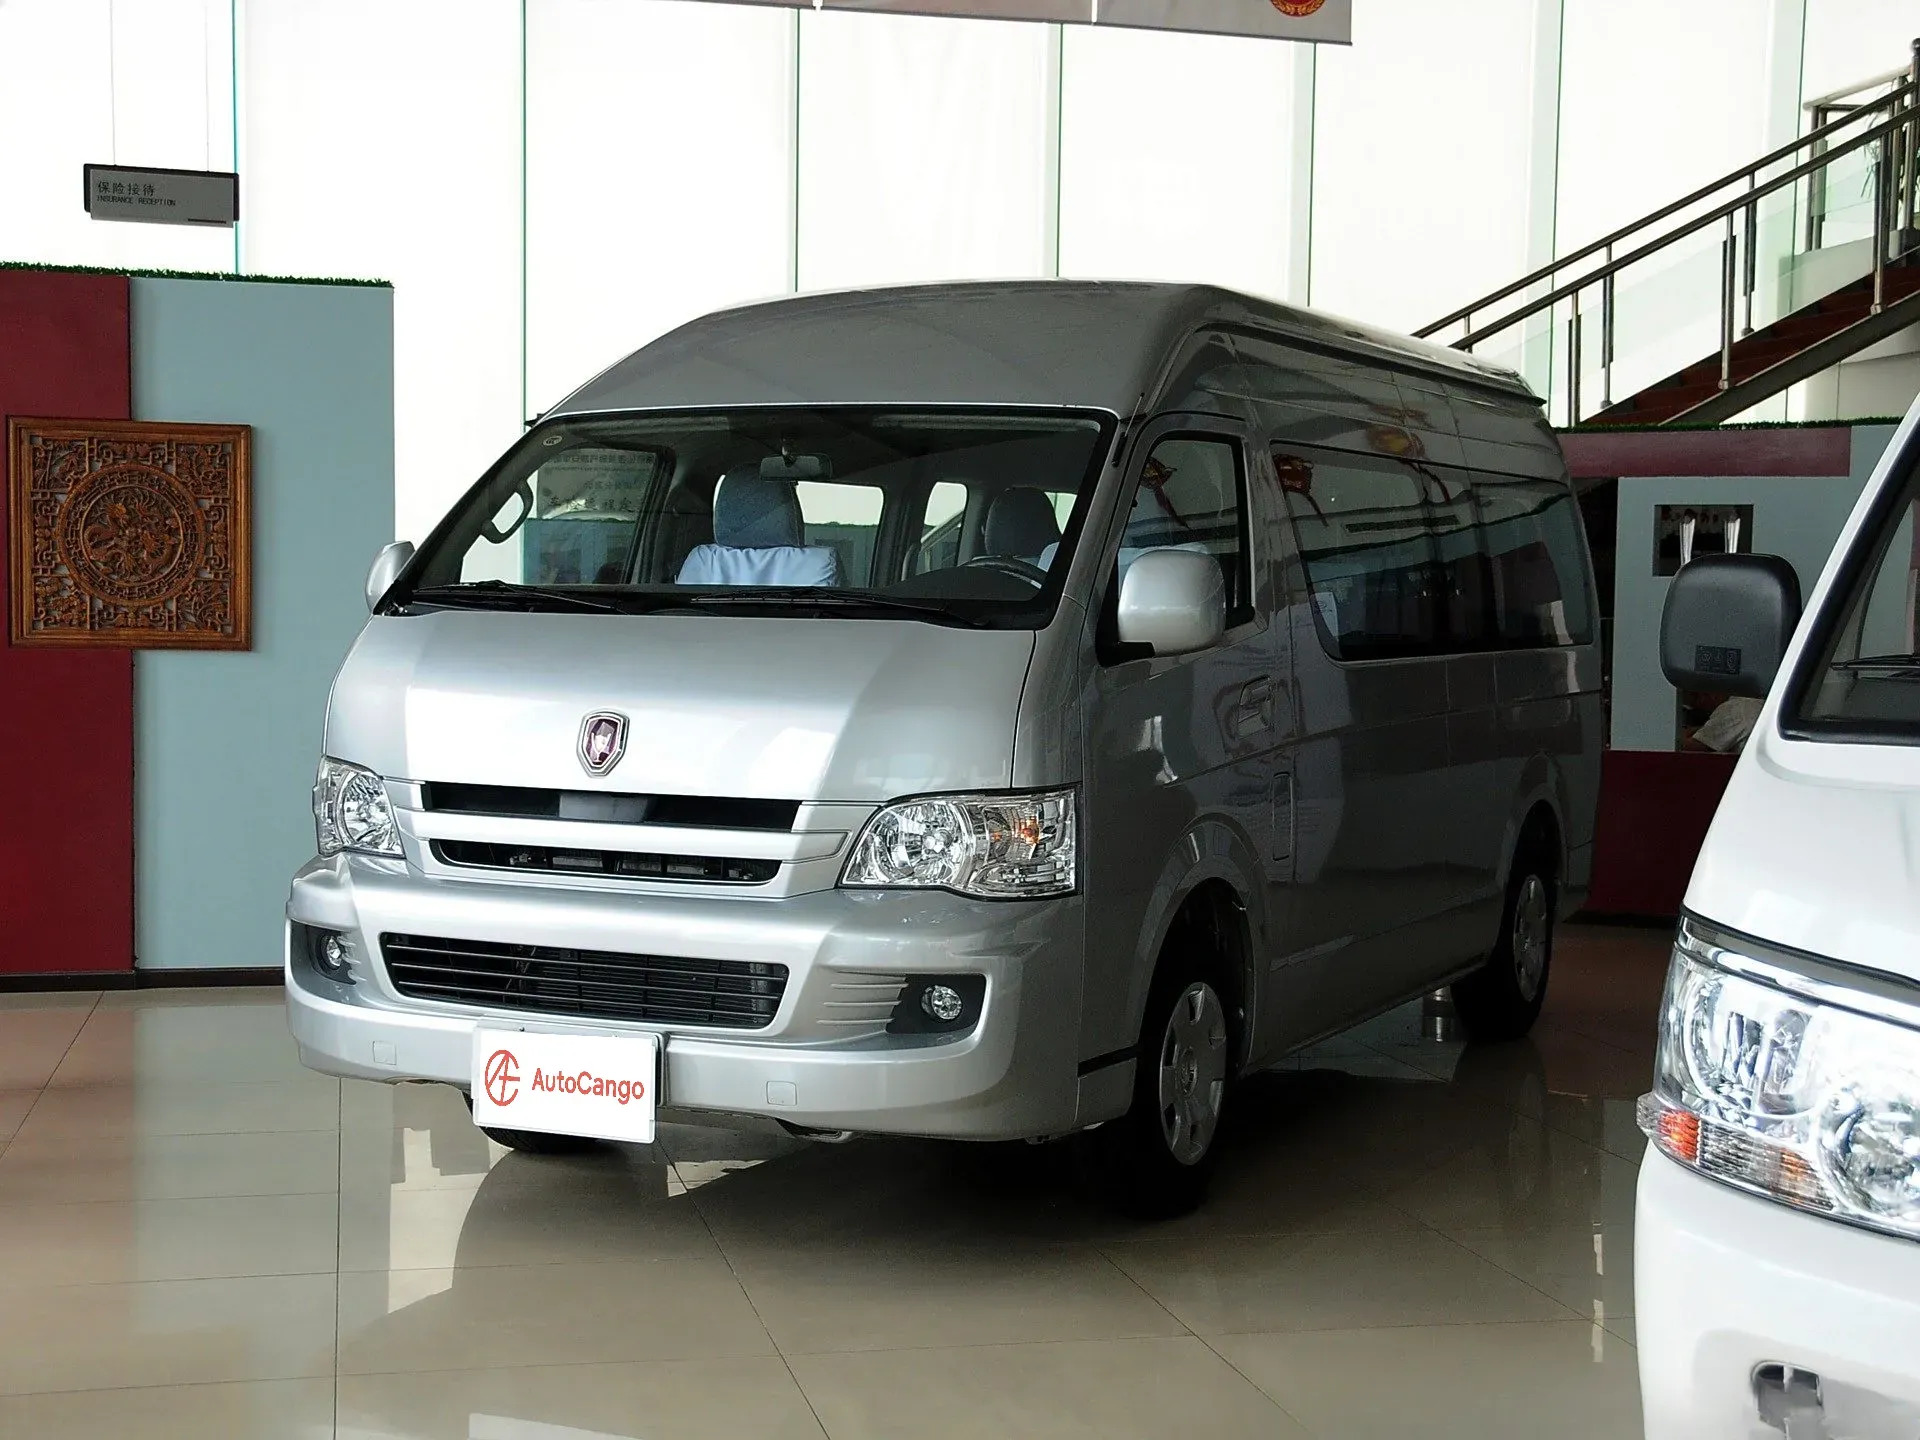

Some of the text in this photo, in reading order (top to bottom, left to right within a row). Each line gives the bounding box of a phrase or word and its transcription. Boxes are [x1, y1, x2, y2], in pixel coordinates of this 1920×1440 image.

[97, 181, 155, 197] 保险接待
[97, 195, 177, 207] INSURANCE RECEPTION
